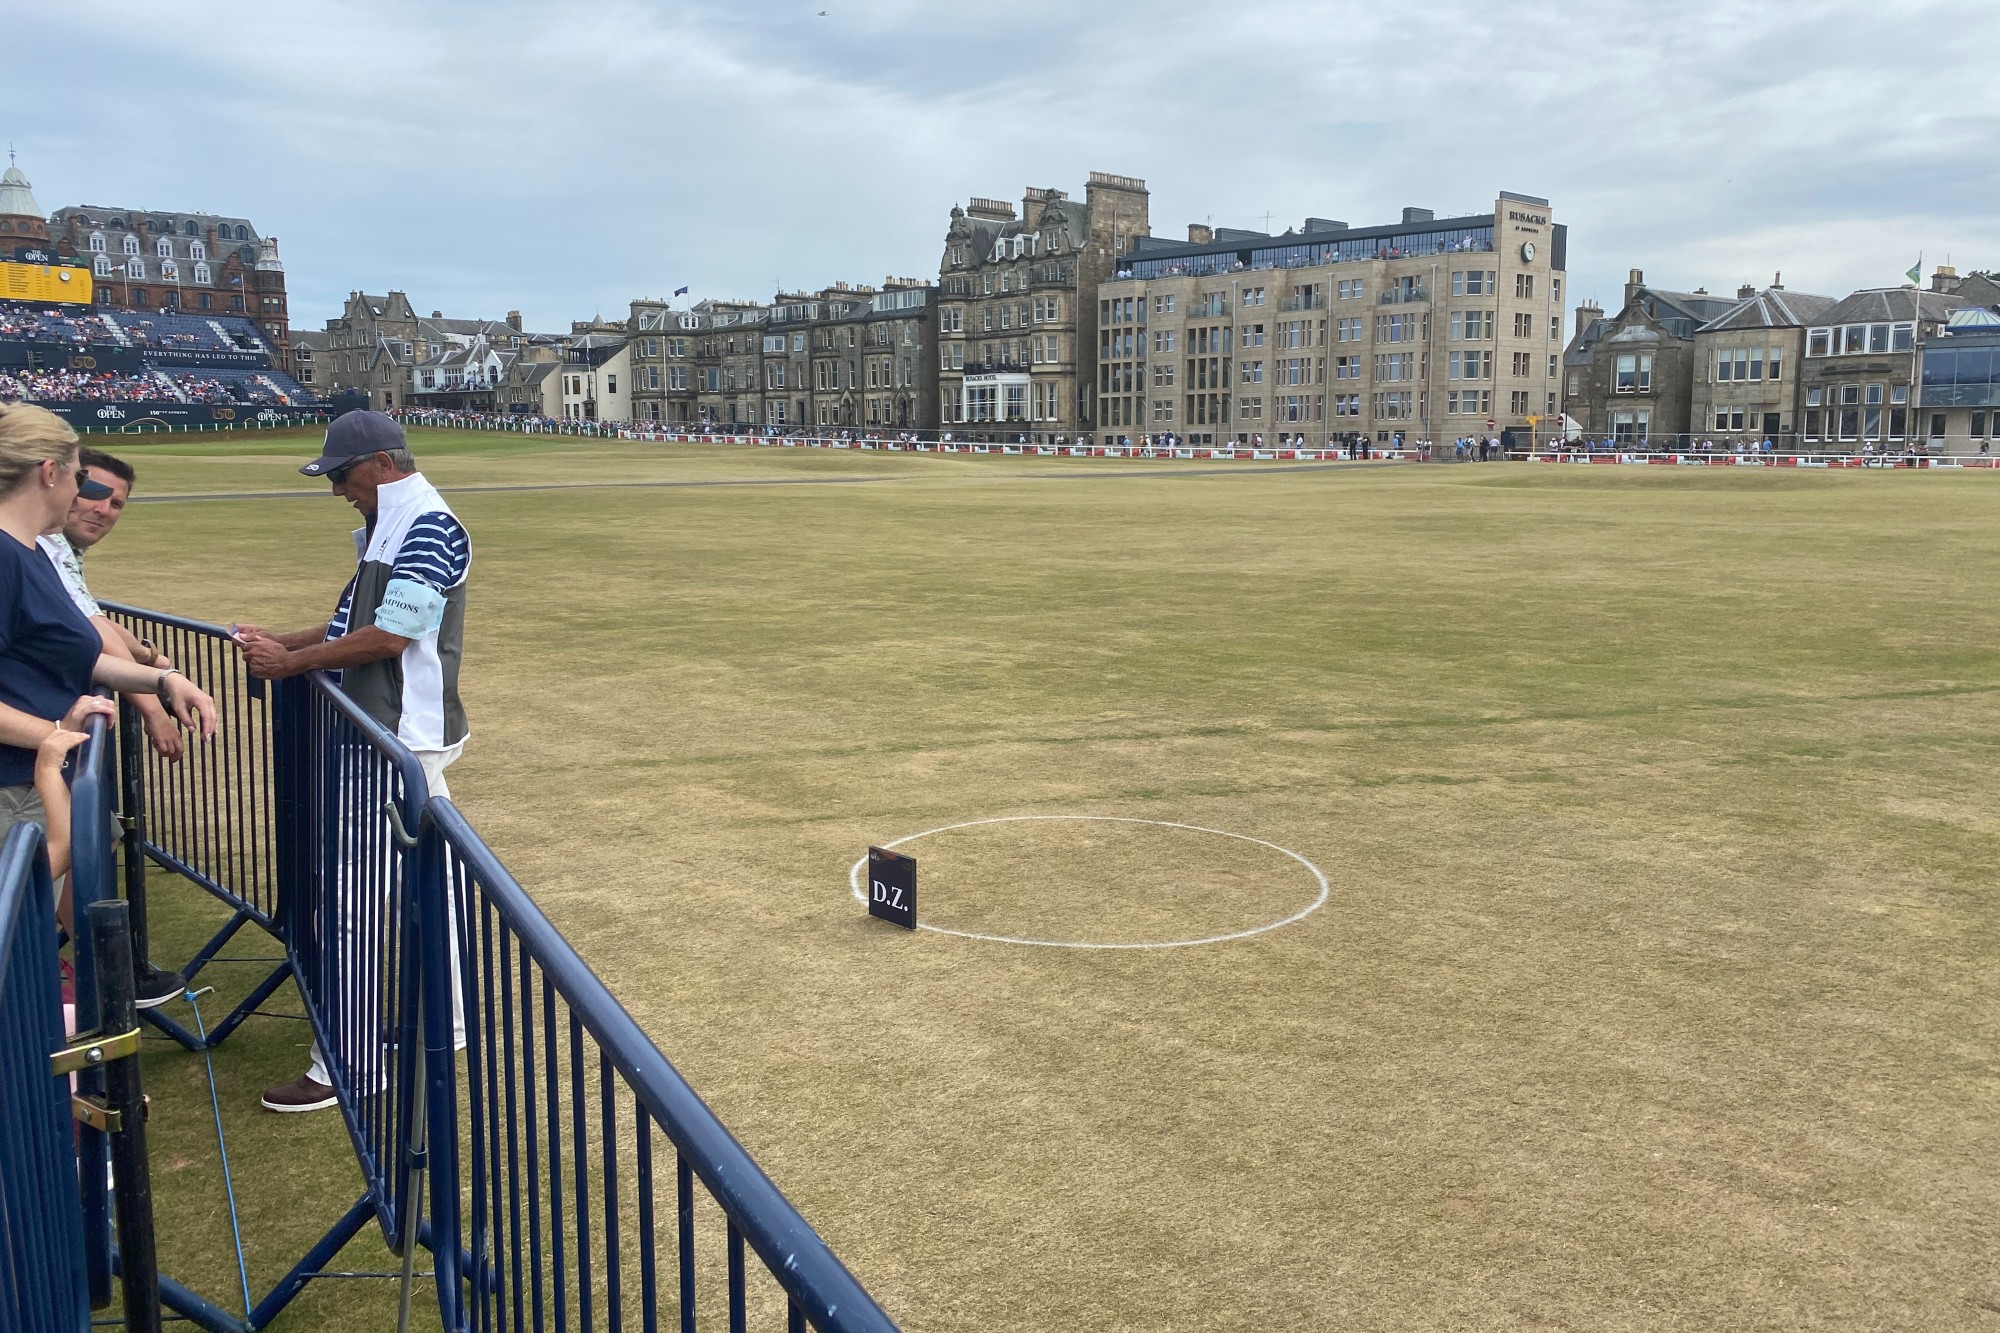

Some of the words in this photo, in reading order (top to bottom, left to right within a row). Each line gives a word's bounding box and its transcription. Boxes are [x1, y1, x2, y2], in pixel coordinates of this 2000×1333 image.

[1509, 211, 1546, 225] RUSACKS
[25, 252, 48, 261] OPEN
[143, 350, 192, 358] EVERYTHING
[97, 409, 125, 418] OPEN
[257, 412, 281, 420] OPEN
[873, 880, 909, 912] D.Z.
